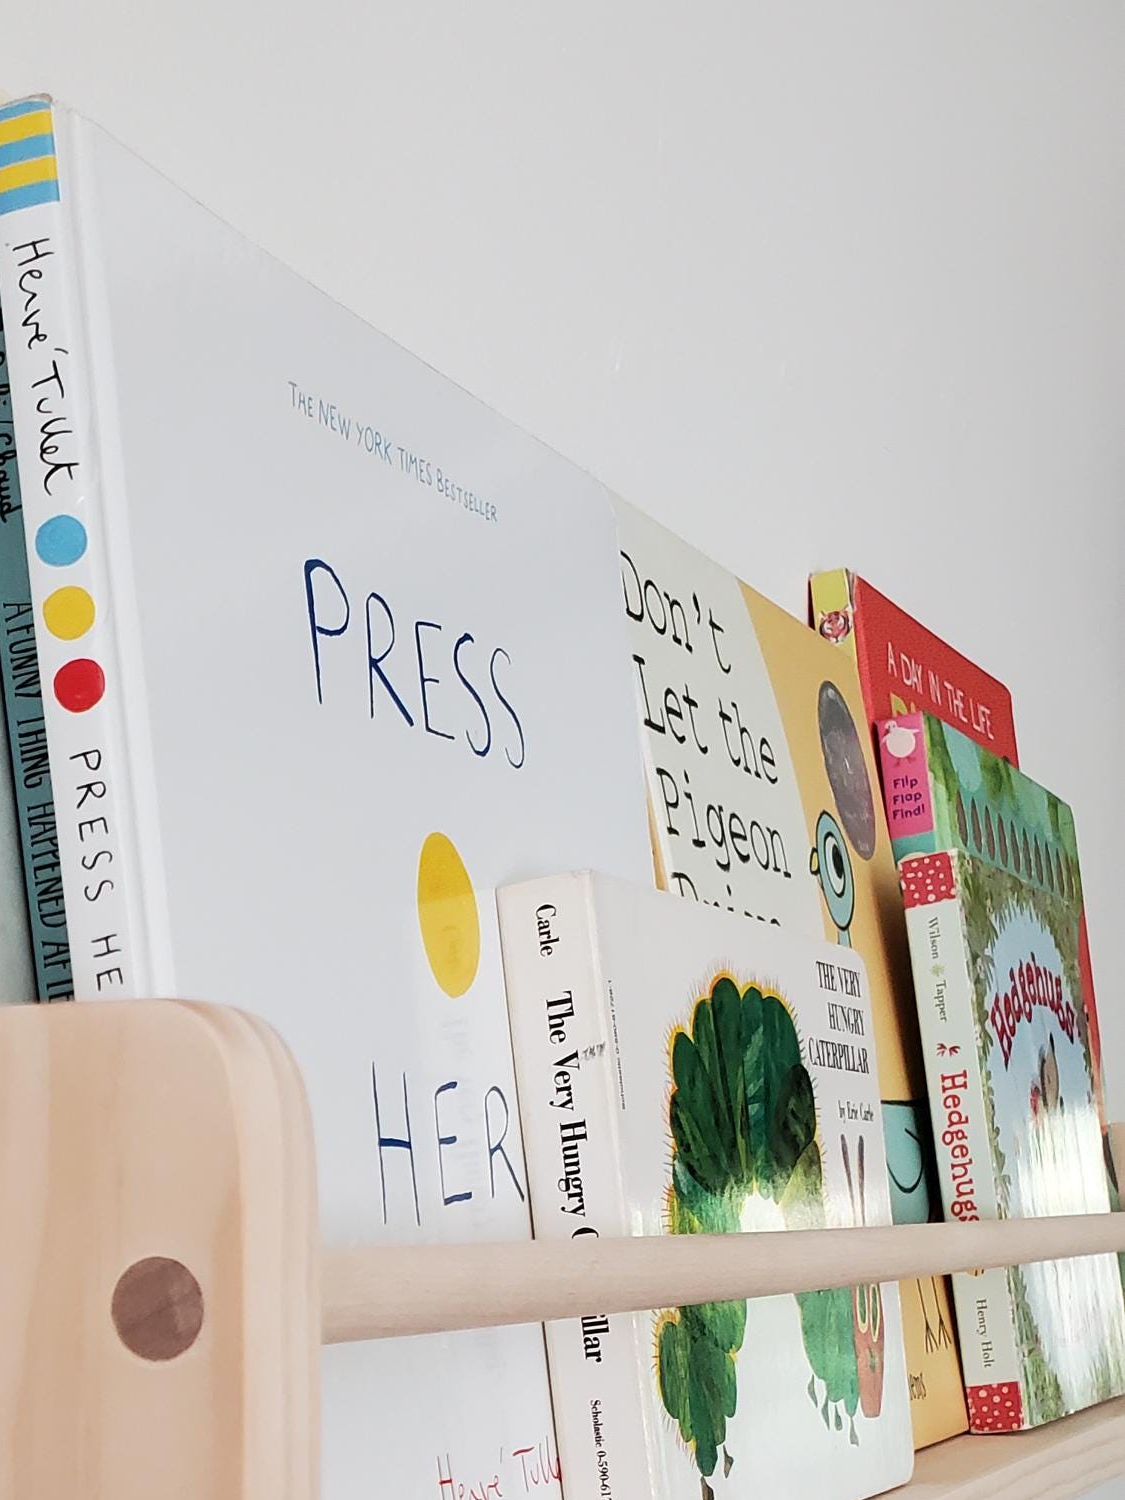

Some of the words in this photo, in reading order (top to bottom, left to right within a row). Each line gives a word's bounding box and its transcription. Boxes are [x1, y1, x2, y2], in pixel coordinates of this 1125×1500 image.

[31, 360, 80, 497] Tullet
[288, 381, 314, 418] THE
[318, 399, 351, 440] NEW
[356, 422, 392, 465] YORK
[397, 446, 433, 487] TIMES
[436, 468, 497, 522] BESTSELLER
[3, 601, 34, 621] A
[619, 549, 731, 674] Don't
[5, 624, 43, 700] FUNNY
[304, 559, 525, 769] PRESS
[887, 641, 898, 677] A
[900, 652, 923, 694] DAY
[928, 670, 941, 706] IN
[944, 681, 968, 723] THE
[969, 698, 995, 740] LIFE
[15, 718, 52, 790] THING
[632, 654, 708, 754] Let
[719, 702, 778, 785] the
[892, 792, 922, 805] Flap
[893, 775, 918, 789] Flip
[69, 748, 115, 902] PRESS
[655, 767, 791, 879] Pigeon
[26, 801, 68, 930] HAPPENED
[535, 904, 560, 957] Carle
[928, 917, 942, 959] Wilson
[816, 961, 837, 992] THE
[837, 967, 861, 998] VERY
[934, 980, 949, 1023] Tapper
[546, 990, 575, 1045] The
[827, 1002, 865, 1037] HUNGRY
[549, 1050, 581, 1111] Very
[808, 1037, 870, 1075] CATERPILLAR
[372, 1061, 526, 1227] HER
[838, 1100, 846, 1124] by
[847, 1102, 859, 1122] Eric
[859, 1104, 874, 1123] Carle
[556, 1118, 588, 1217] Hungry
[976, 1299, 986, 1338] Henry
[982, 1340, 995, 1368] Holt
[590, 1399, 606, 1448] Scholastic
